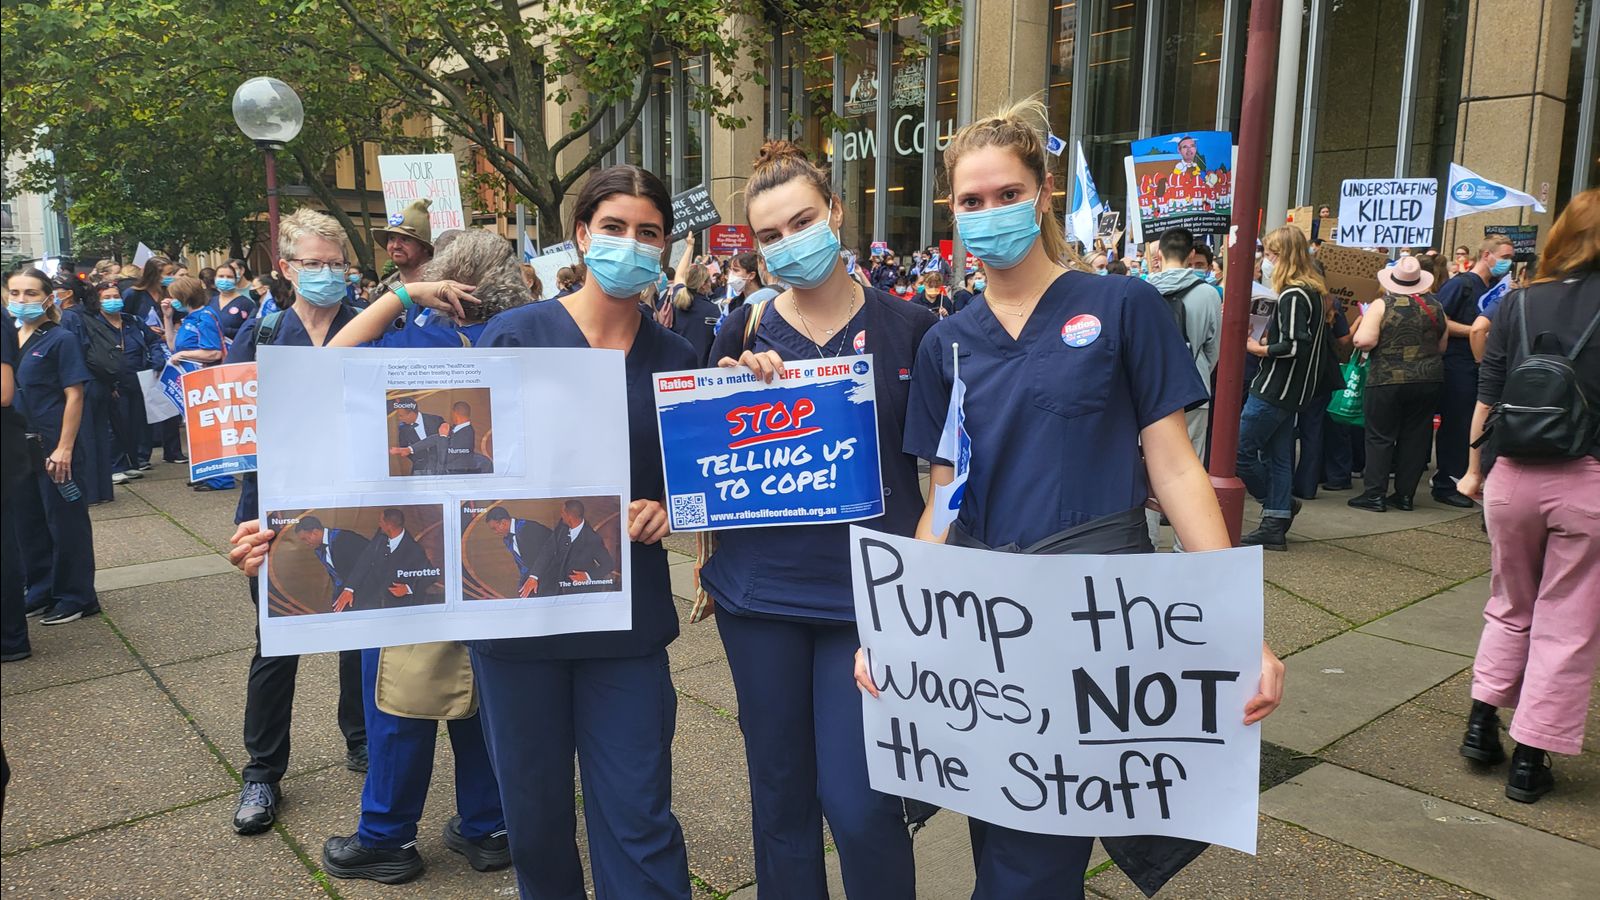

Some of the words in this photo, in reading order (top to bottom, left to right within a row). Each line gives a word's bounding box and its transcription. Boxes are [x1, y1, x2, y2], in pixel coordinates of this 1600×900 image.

[827, 128, 877, 162] aw
[404, 162, 433, 180] YOUR
[384, 180, 418, 199] PATIENT
[425, 178, 456, 198] SAFETY
[688, 190, 708, 204] THAN
[1343, 182, 1438, 196] UNDERSTAFFING
[695, 200, 710, 212] WE
[1359, 199, 1422, 222] KILLED
[695, 210, 718, 223] RAISE
[1341, 225, 1368, 244] MY
[1374, 225, 1432, 244] PATIENT
[1329, 286, 1354, 298] who
[1066, 321, 1096, 332] Ratios
[660, 379, 694, 390] Ratios
[697, 376, 714, 386] It's
[726, 373, 760, 384] matte
[804, 369, 814, 377] or
[817, 364, 850, 376] DEATH
[200, 404, 257, 428] EVID
[726, 398, 815, 436] STOP
[221, 427, 257, 446] BA
[697, 444, 812, 477] TELLING
[823, 438, 858, 462] US
[196, 461, 239, 474] #SafeStaffing
[715, 478, 750, 501] TO
[760, 464, 837, 495] COPE!
[271, 516, 300, 525] Nurses
[710, 506, 837, 522] www.ratioslifeordeath.org.au
[397, 566, 440, 578] Perrottet
[572, 578, 613, 587] Government
[860, 537, 1033, 673] Pump
[1072, 576, 1207, 652] the
[1072, 666, 1240, 734] NOT
[876, 718, 970, 791] the
[1000, 750, 1187, 819] Staff
